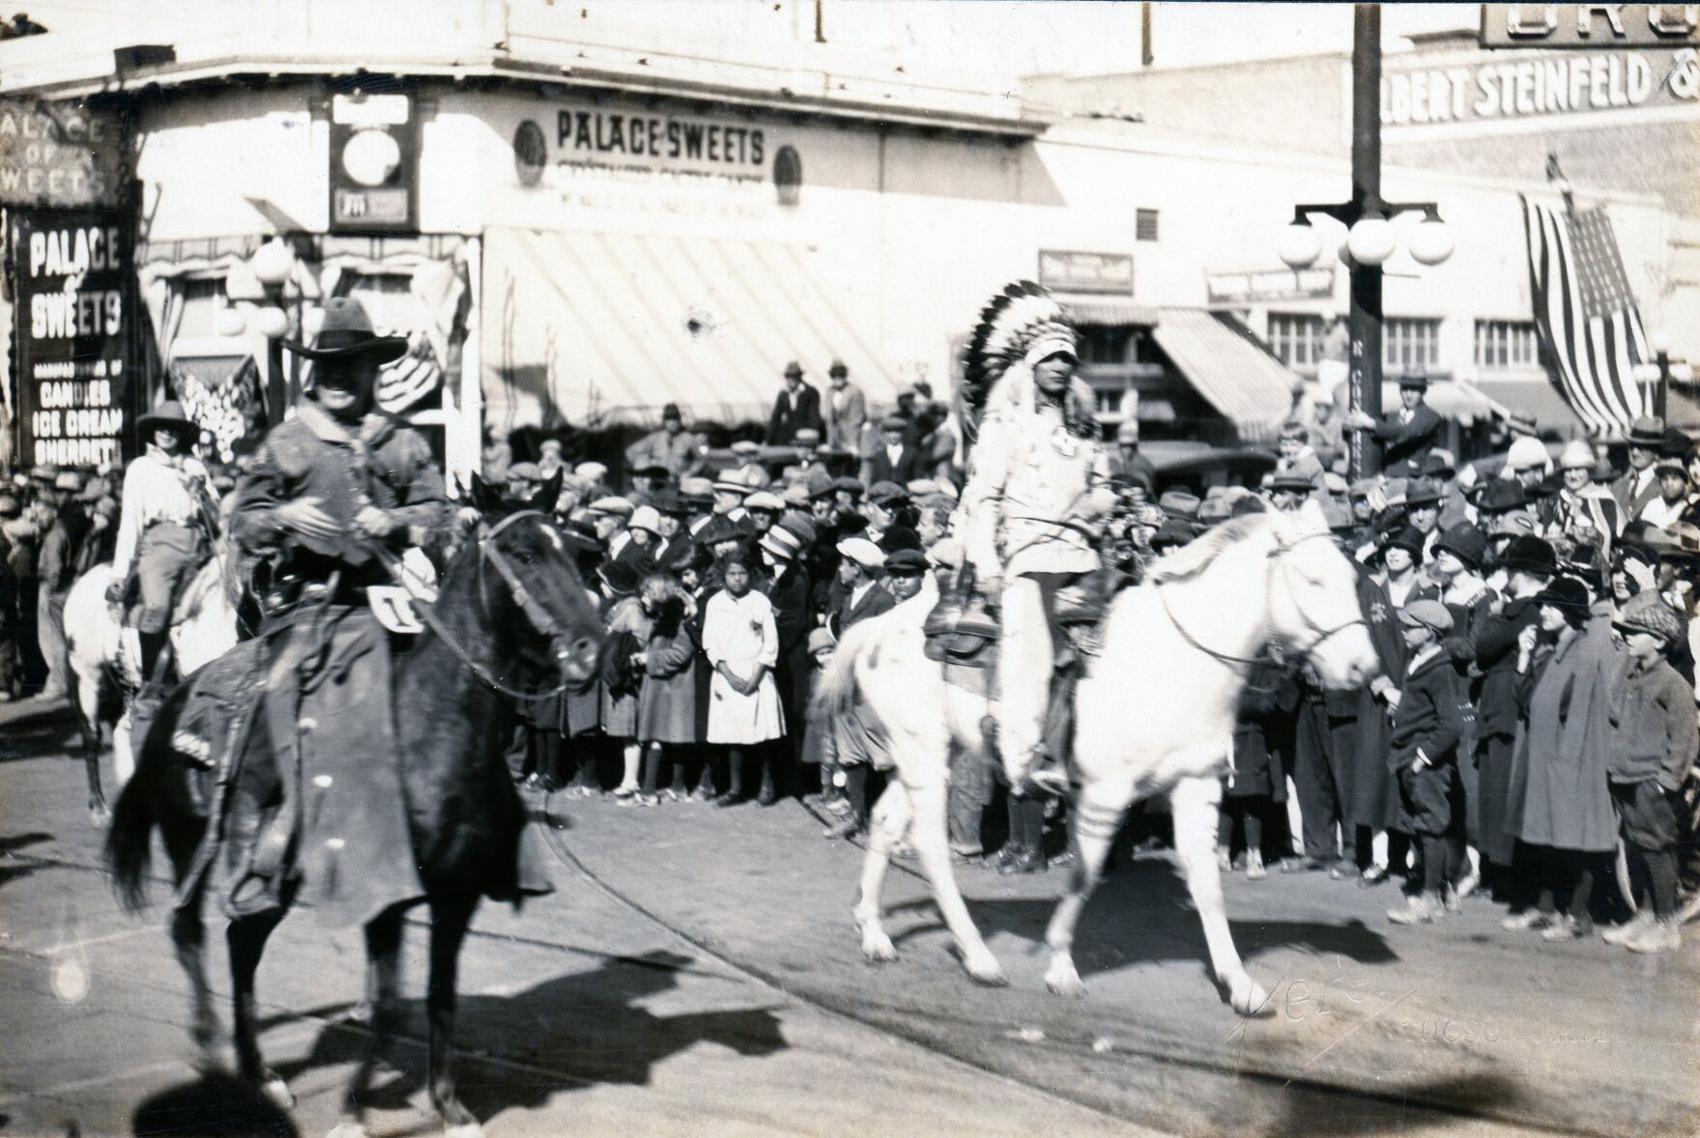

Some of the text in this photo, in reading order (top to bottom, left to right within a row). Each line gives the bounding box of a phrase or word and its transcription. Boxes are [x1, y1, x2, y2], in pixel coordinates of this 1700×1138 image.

[1380, 47, 1699, 124] LBERT STEINFELD &
[0, 112, 104, 143] ALACE
[557, 109, 765, 166] PALACE SWEETS
[0, 166, 105, 196] WEETS
[30, 226, 121, 278] PALACE
[31, 289, 122, 339] SWEETS
[40, 379, 111, 409] CANDIES
[32, 408, 123, 438] ICE CREAM
